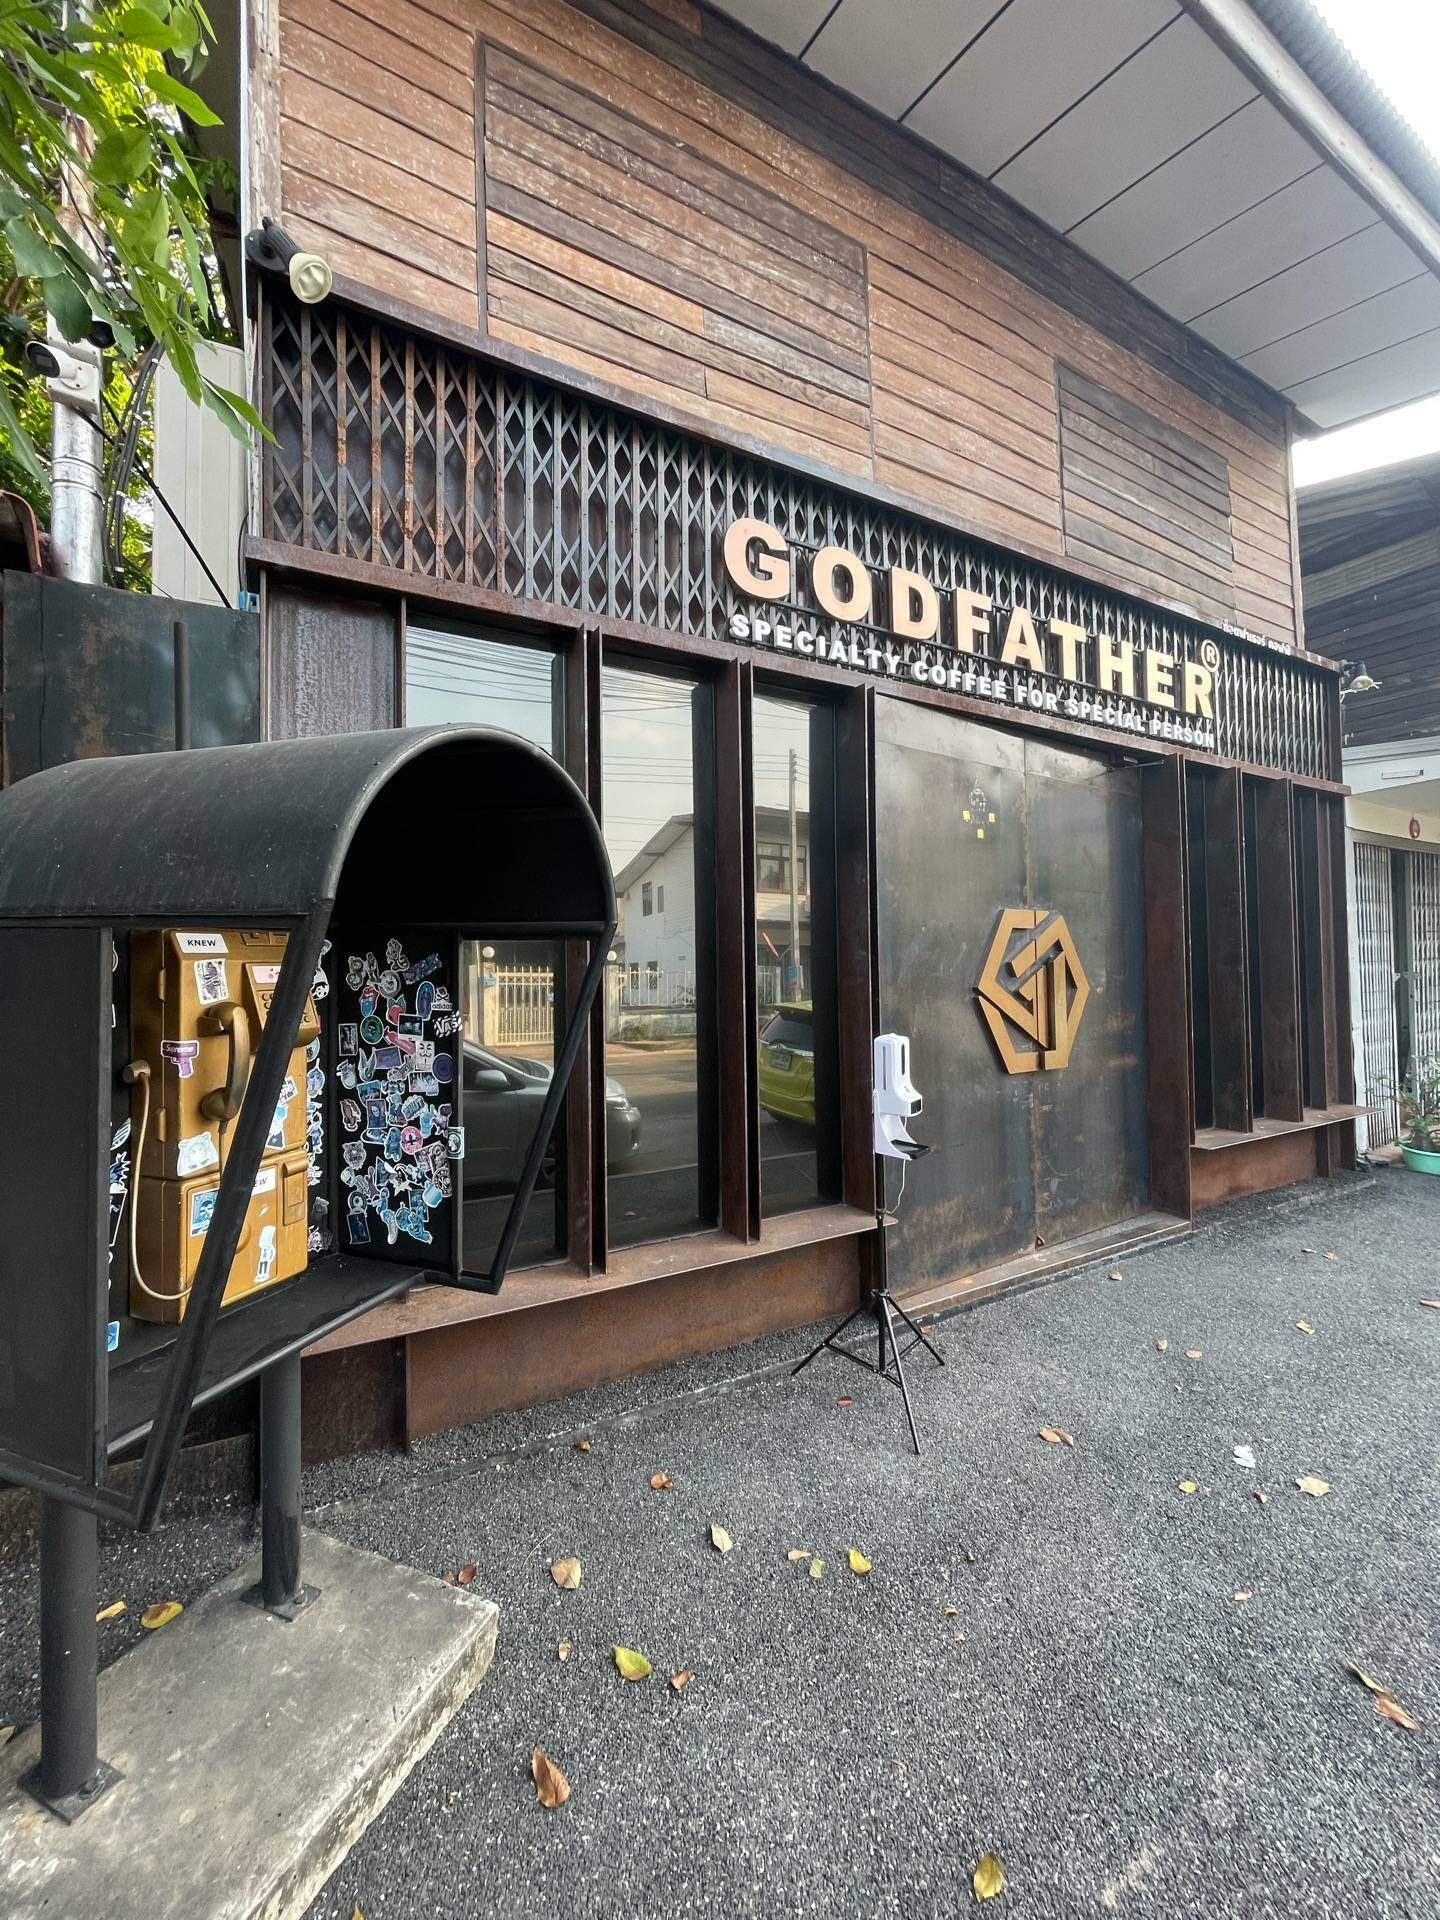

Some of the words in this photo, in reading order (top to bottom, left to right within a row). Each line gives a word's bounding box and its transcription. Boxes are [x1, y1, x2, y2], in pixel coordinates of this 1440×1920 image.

[724, 517, 1214, 719] GODFATHER
[729, 613, 901, 675] SPECIALTY
[911, 660, 1007, 700] COFFEE
[1014, 685, 1058, 712] FOR
[1064, 698, 1145, 732] SPECIAL
[1149, 719, 1215, 749] PERSON
[187, 939, 217, 947] KNEW
